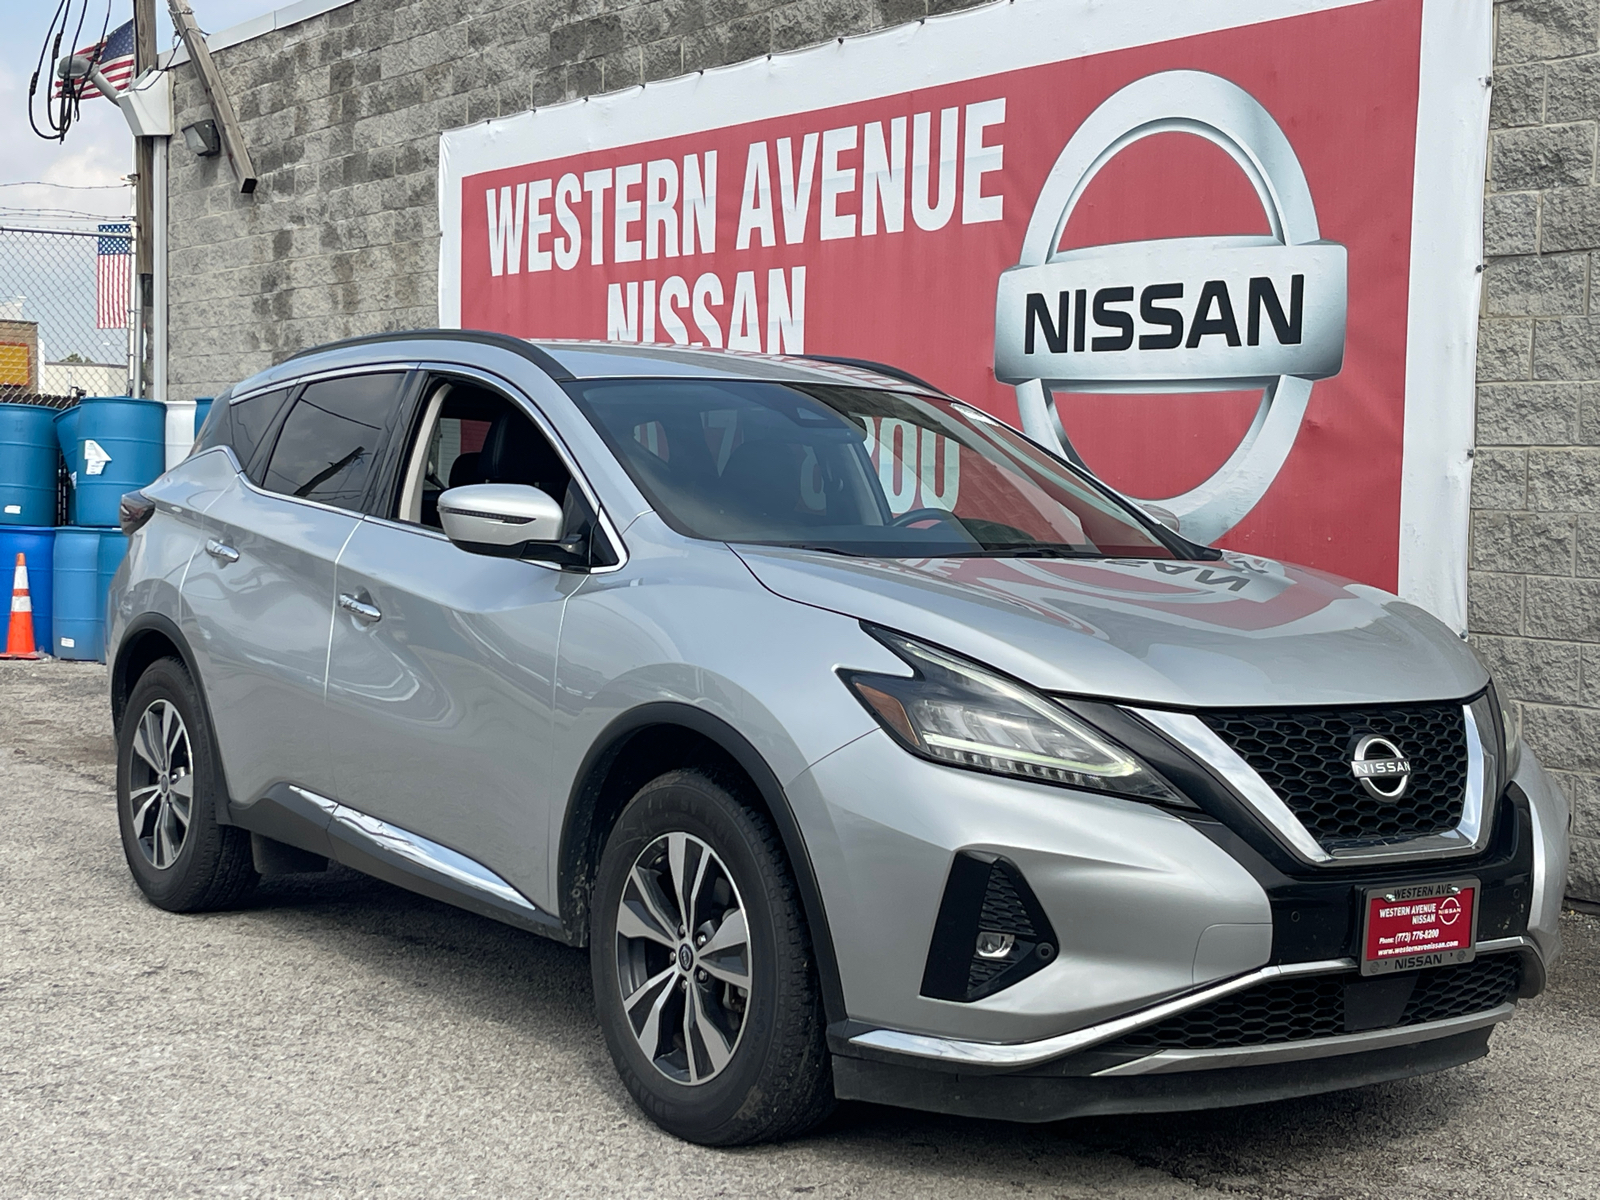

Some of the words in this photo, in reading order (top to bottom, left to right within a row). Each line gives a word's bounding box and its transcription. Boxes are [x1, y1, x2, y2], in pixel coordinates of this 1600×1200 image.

[486, 151, 717, 277] WESTERN
[736, 97, 1006, 250] AVENUE
[608, 266, 807, 355] NISSAN
[1024, 274, 1304, 354] NISSAN
[1355, 761, 1411, 775] NISSAN
[1394, 885, 1434, 899] WESTERN
[1379, 906, 1411, 918] WESTERN
[1411, 903, 1436, 914] AVENUE
[1412, 914, 1436, 925] NISSAN
[1395, 932, 1411, 944] (773)
[1412, 928, 1440, 940] 776-8200
[1378, 941, 1459, 956] www.westernavenissan.com
[1394, 953, 1443, 970] NISSAN
